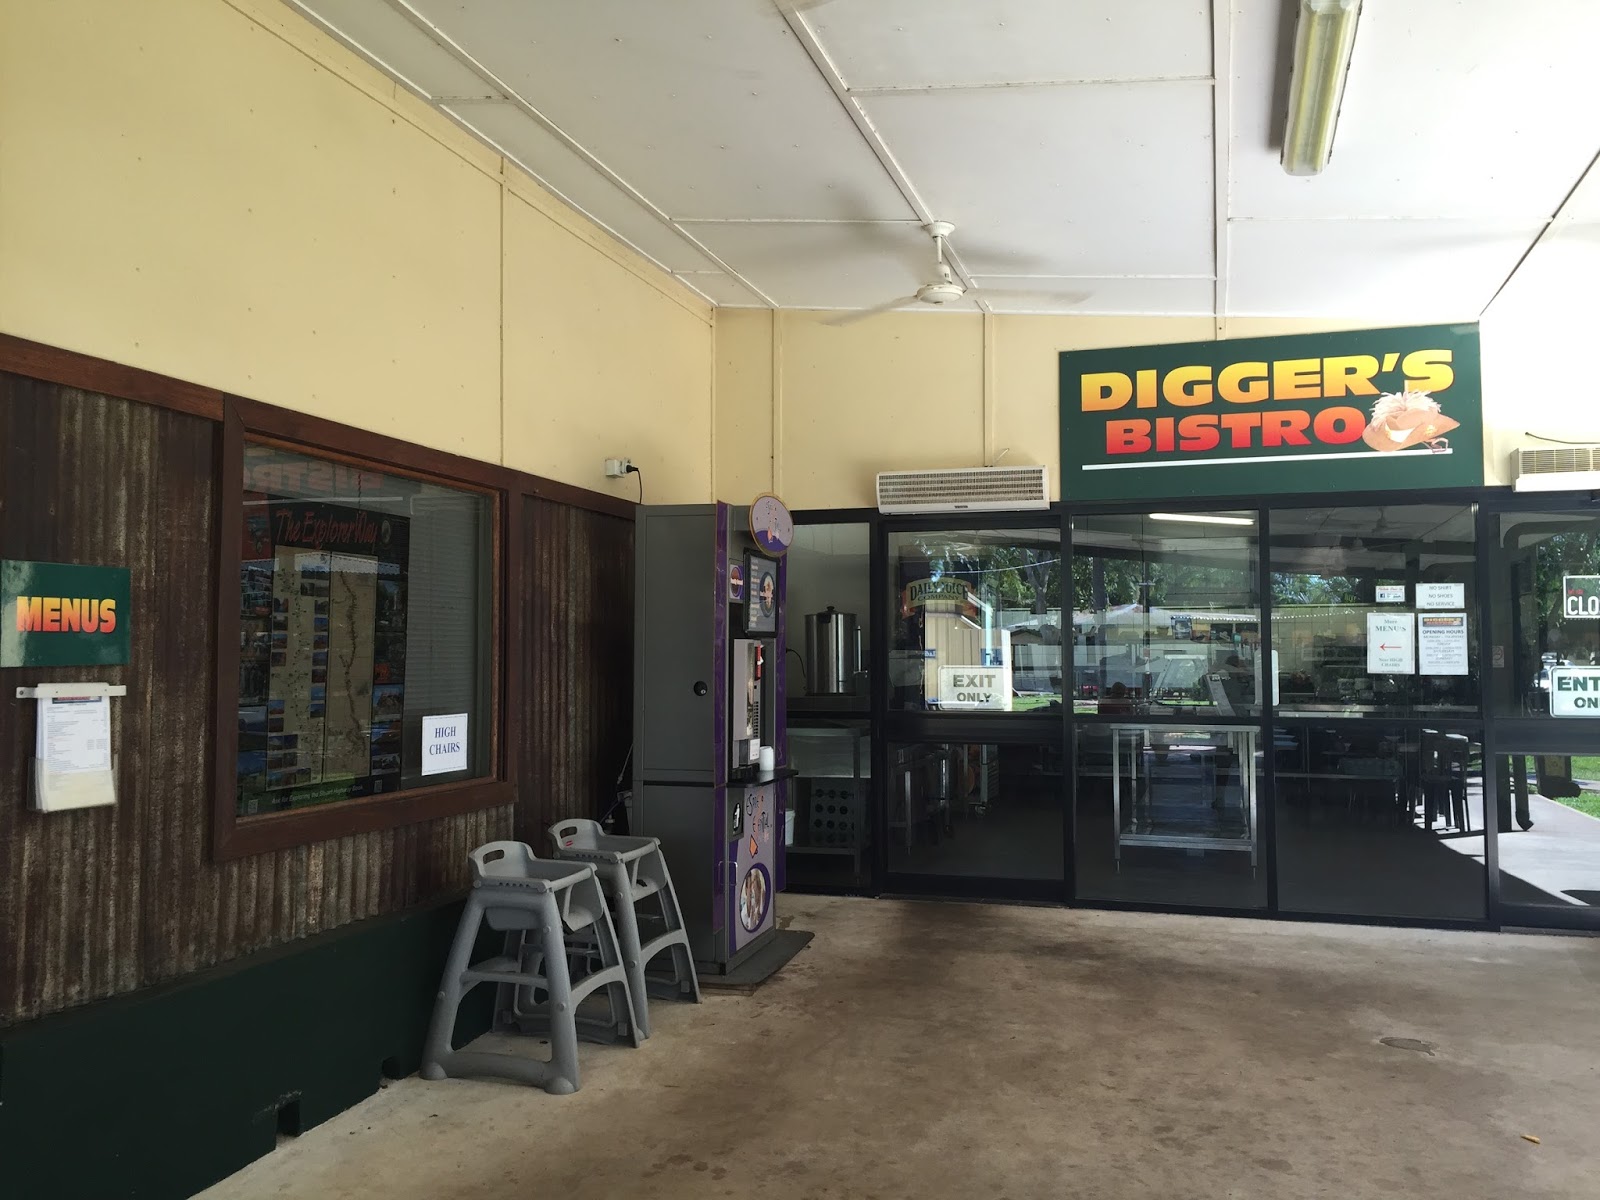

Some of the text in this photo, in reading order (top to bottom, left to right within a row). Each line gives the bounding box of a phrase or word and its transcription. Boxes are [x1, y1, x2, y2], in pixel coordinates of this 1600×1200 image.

[1081, 349, 1454, 412] DIGGER'S
[1106, 406, 1367, 455] BISTRO
[276, 508, 301, 543] The
[302, 511, 354, 550] Explorer
[916, 593, 961, 601] COMPANY
[16, 595, 116, 633] MENUS
[953, 674, 996, 687] EXIT
[1557, 676, 1600, 691] ENT
[956, 692, 992, 703] ONLY
[434, 726, 457, 738] HIGH
[429, 741, 461, 755] CHAIRS
